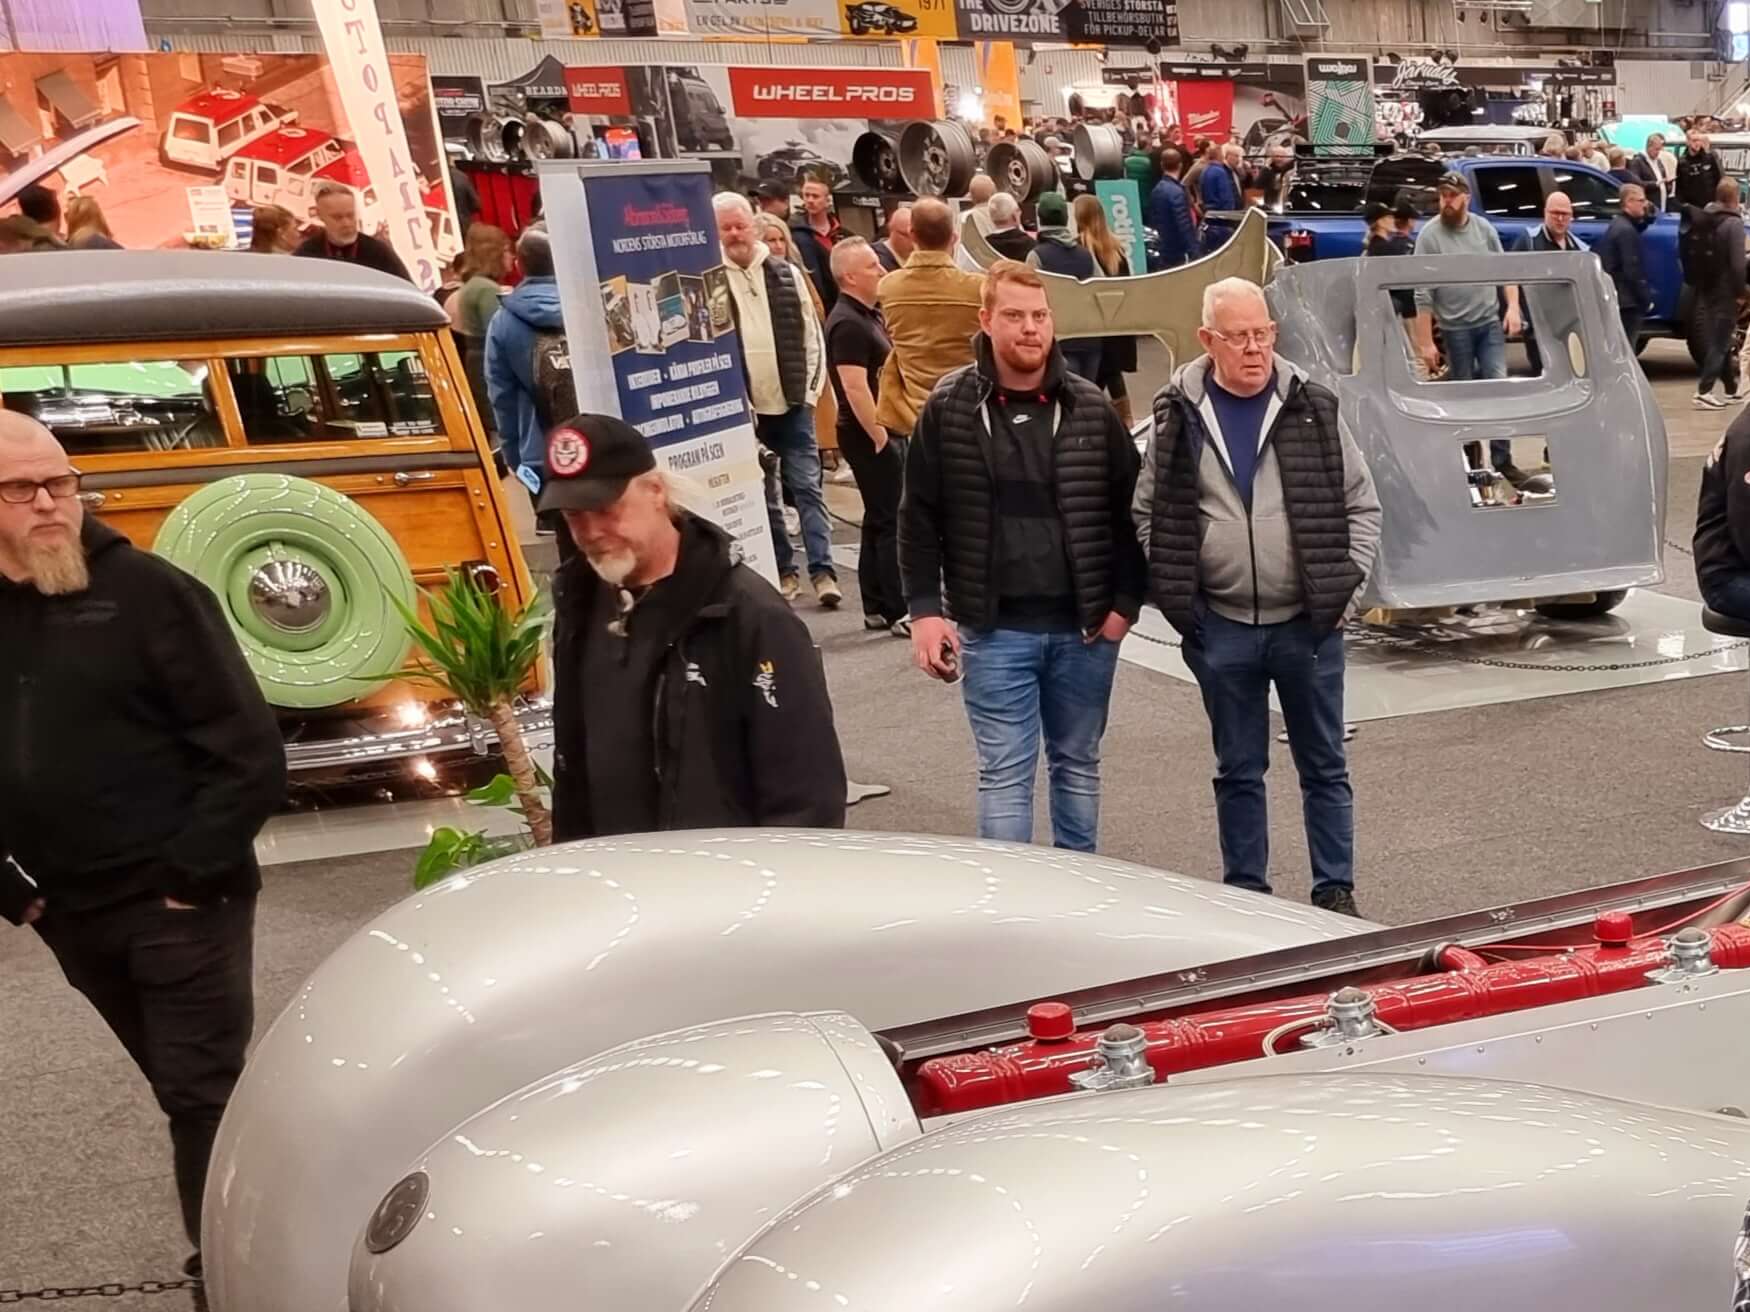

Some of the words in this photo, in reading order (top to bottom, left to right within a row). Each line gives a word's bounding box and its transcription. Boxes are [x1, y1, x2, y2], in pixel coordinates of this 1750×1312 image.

[970, 13, 1061, 33] DRIVEZONE
[668, 447, 701, 471] PROGRAM
[700, 441, 709, 463] PÅ
[709, 442, 725, 461] SCEN
